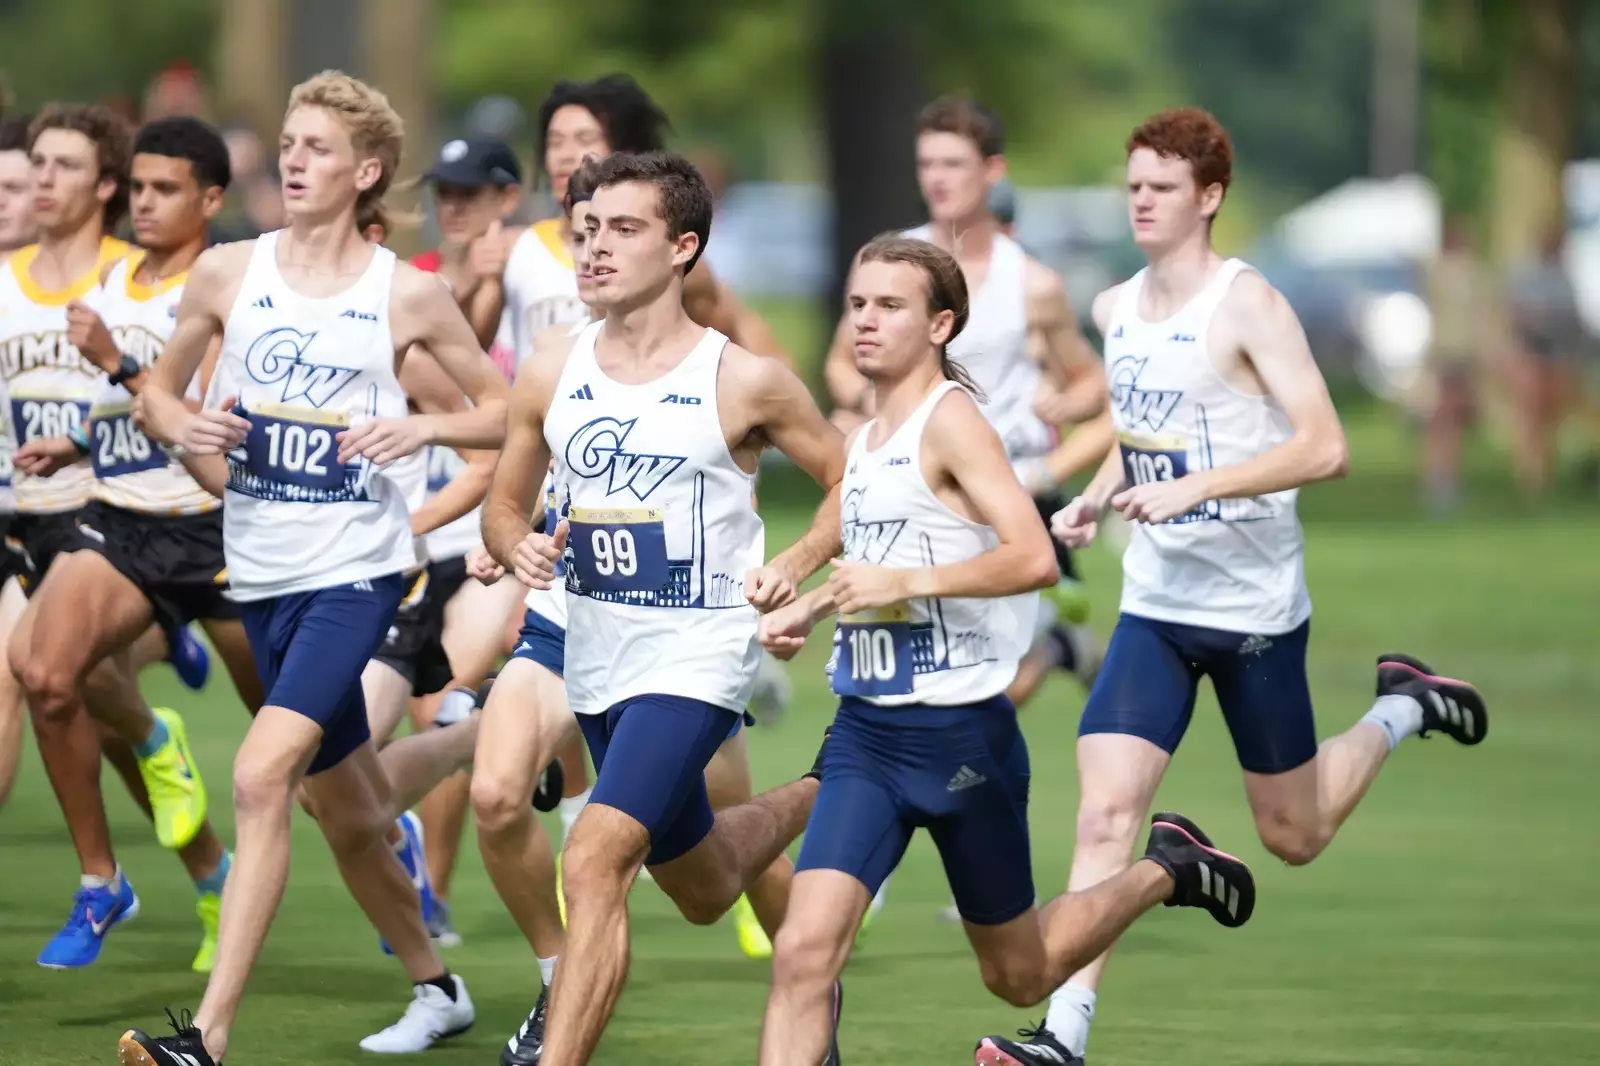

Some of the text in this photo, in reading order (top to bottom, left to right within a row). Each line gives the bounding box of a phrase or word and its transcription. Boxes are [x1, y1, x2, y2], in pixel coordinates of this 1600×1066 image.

[245, 327, 364, 409] GW
[265, 422, 332, 476] 102
[565, 416, 688, 501] GW
[1128, 451, 1176, 487] 103
[591, 529, 638, 576] 99
[849, 628, 897, 682] 100
